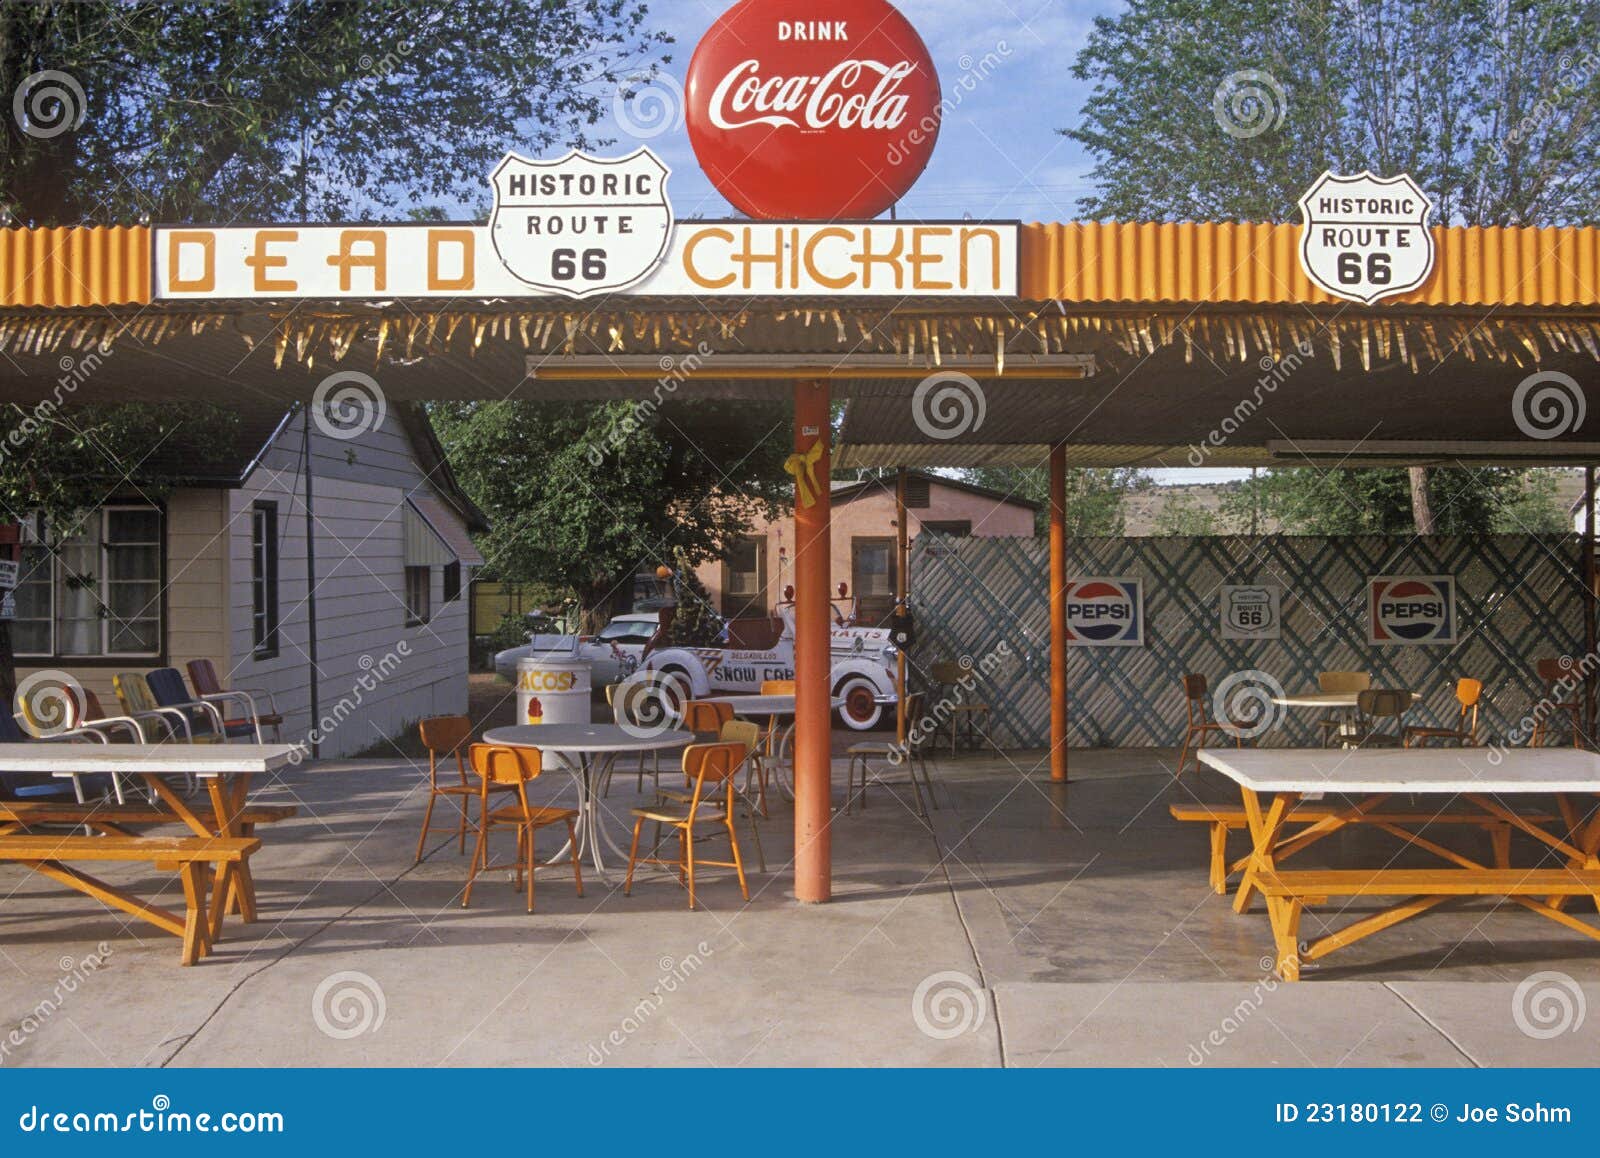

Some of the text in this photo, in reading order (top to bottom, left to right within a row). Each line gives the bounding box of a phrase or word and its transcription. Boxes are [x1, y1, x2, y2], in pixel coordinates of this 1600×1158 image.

[778, 21, 848, 41] DRINK
[708, 59, 919, 130] Coca-Cola
[509, 173, 651, 196] HISTORIC
[1319, 198, 1414, 214] HISTORIC
[527, 215, 633, 235] ROUTE
[1323, 228, 1411, 248] ROUTE
[168, 227, 1000, 293] DEAD CHICKEN
[551, 248, 607, 281] 66
[1337, 253, 1392, 285] 66
[1067, 603, 1130, 619] PEPSI
[1239, 611, 1262, 625] 66
[1381, 602, 1443, 618] PEPSI
[518, 670, 571, 692] ACOS
[714, 666, 757, 682] SNOW
